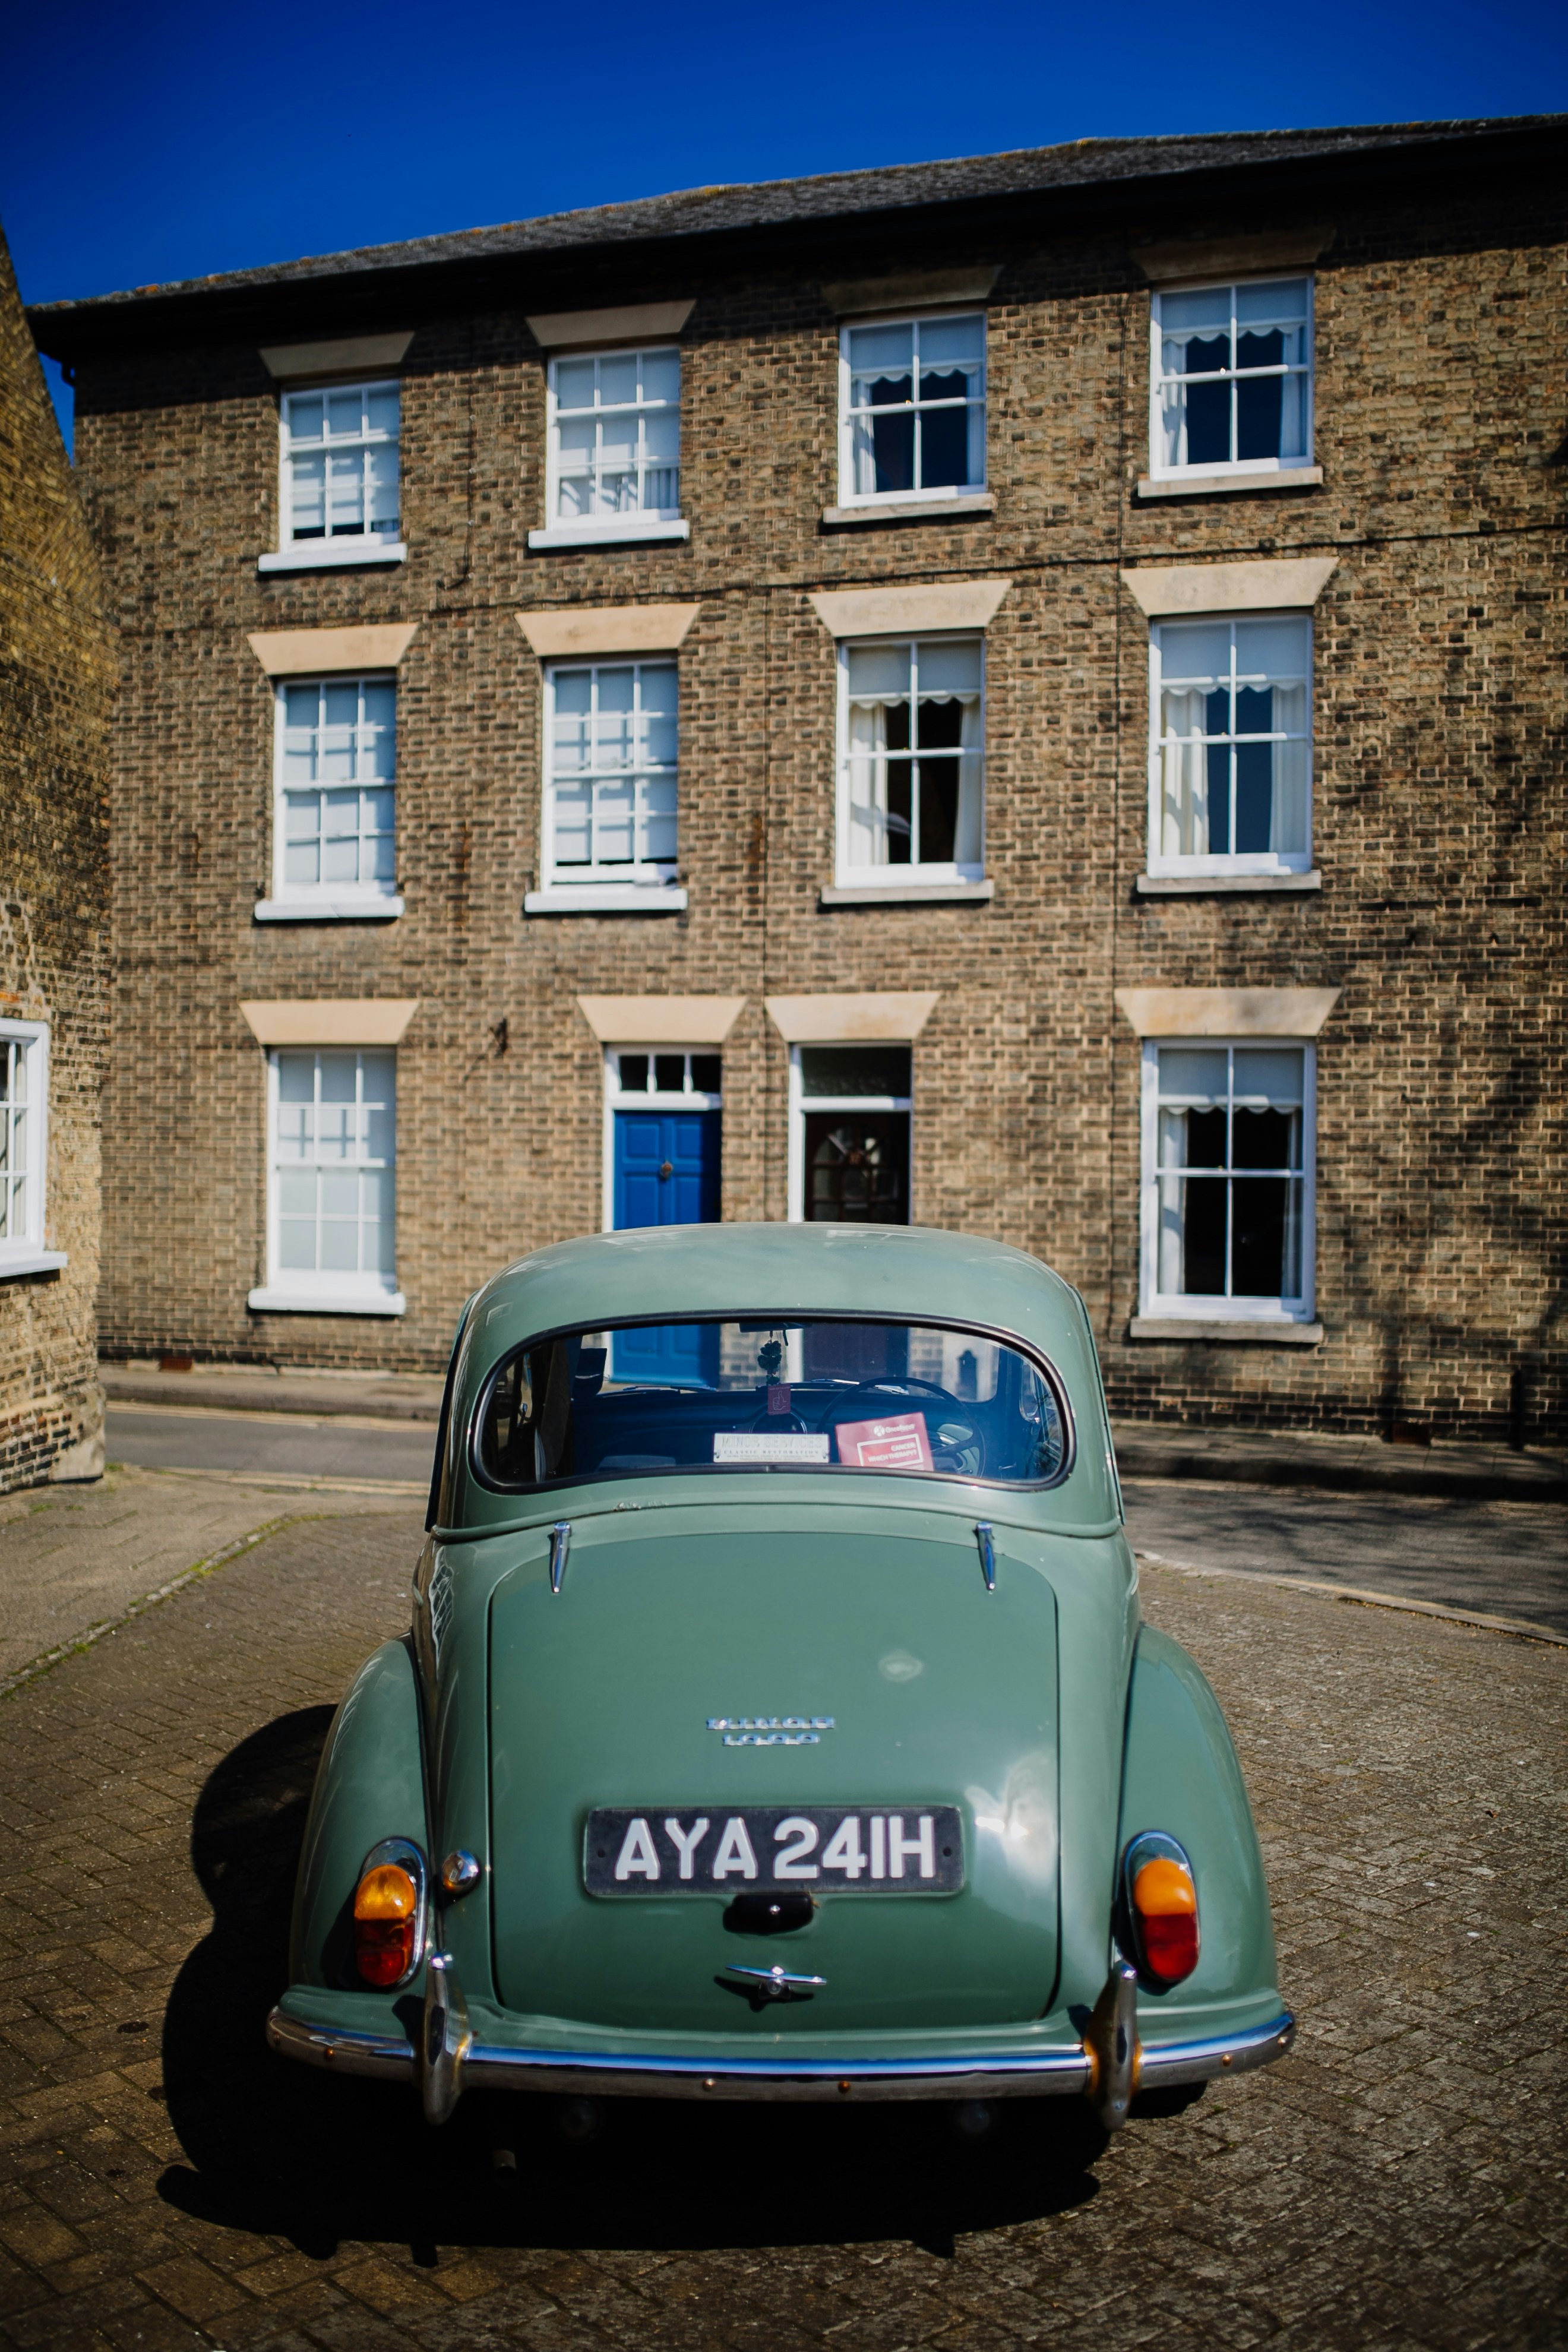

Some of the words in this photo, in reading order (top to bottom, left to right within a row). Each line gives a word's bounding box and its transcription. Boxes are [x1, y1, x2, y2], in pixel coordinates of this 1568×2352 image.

[722, 1436, 760, 1447] MINOR
[765, 1436, 823, 1448] SERVICES
[615, 1816, 758, 1880] AYA
